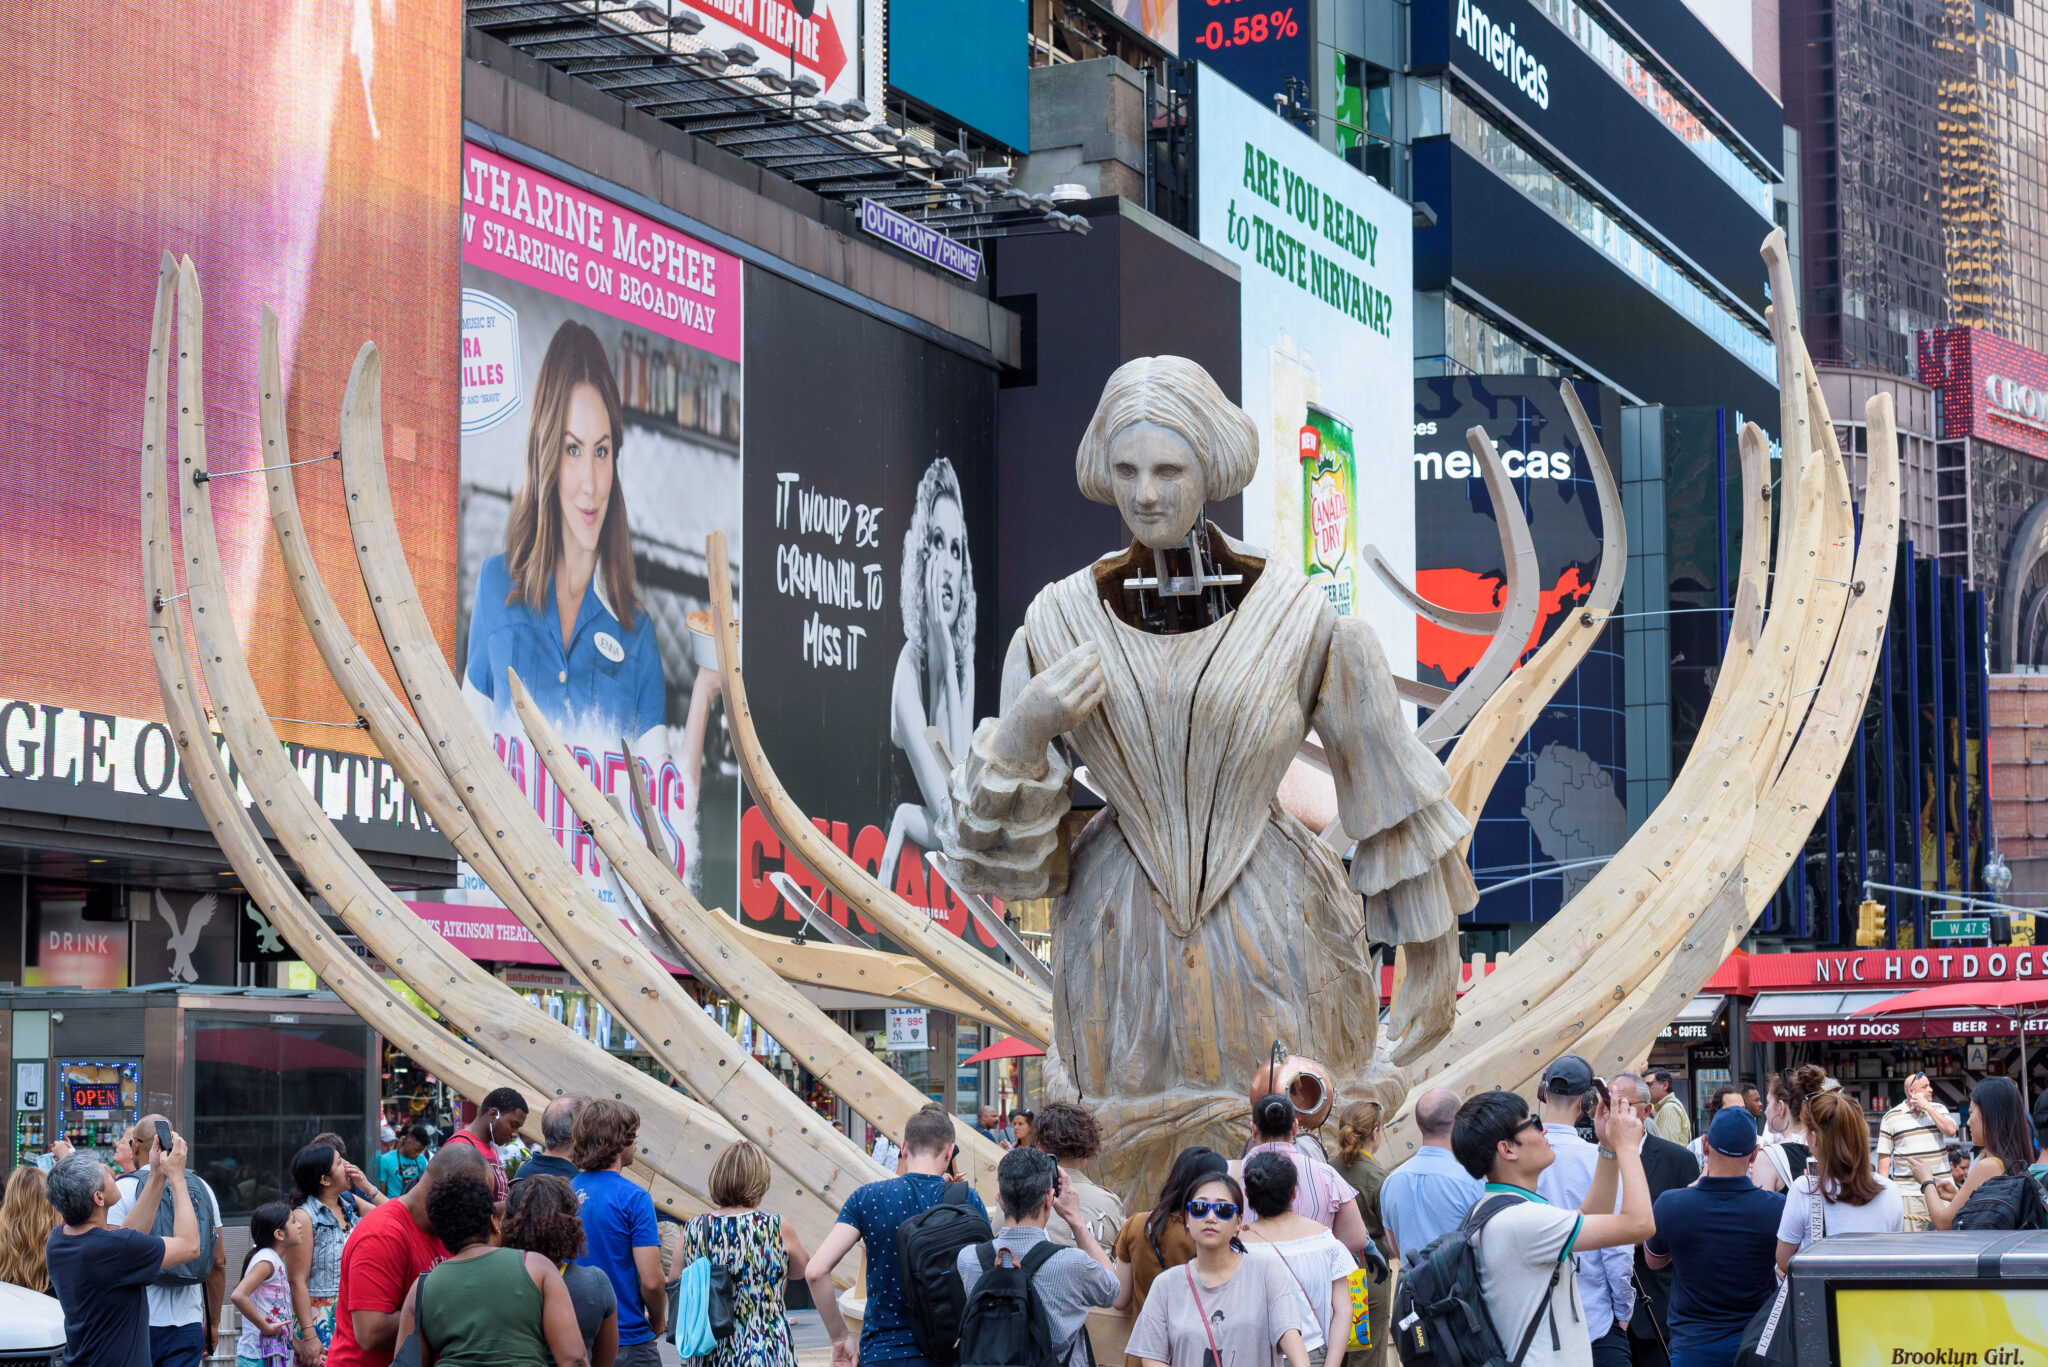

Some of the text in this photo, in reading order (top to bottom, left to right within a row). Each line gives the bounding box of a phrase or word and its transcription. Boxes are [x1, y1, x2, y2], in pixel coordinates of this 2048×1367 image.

[759, 1, 821, 63] THEATRE
[1195, 7, 1298, 50] -0.58%
[1455, 0, 1549, 110] Americas
[1243, 141, 1378, 268] ARE YOU READY
[867, 205, 977, 276] OUTFRONT PRIME
[483, 213, 579, 284] STARRING
[585, 260, 613, 296] ON
[619, 272, 716, 335] BROADWAY
[1228, 198, 1393, 339] to TASTE NIRVANA?
[486, 315, 496, 328] BY
[462, 363, 504, 389] ILLES
[777, 472, 884, 548] IT WOULD BE
[1311, 492, 1348, 537] CANADA
[1322, 523, 1341, 554] DRY
[776, 543, 883, 611] CRIMINAL TO
[1338, 581, 1350, 603] ALE
[803, 611, 868, 671] MISS IT
[464, 875, 486, 891] NOW
[443, 923, 495, 940] ATKINSON
[1950, 923, 1960, 934] W
[1964, 922, 1977, 934] 47
[50, 930, 109, 954] DRINK
[1816, 957, 1865, 982] NYC
[1679, 1025, 1708, 1037] COFFEE
[1772, 1023, 1900, 1037] WINE HOT DOGS
[1952, 1021, 1988, 1033] BEER
[1971, 1048, 1984, 1063] A
[75, 1089, 117, 1106] OPEN
[1891, 1346, 2025, 1367] Brooklyn Girl.
